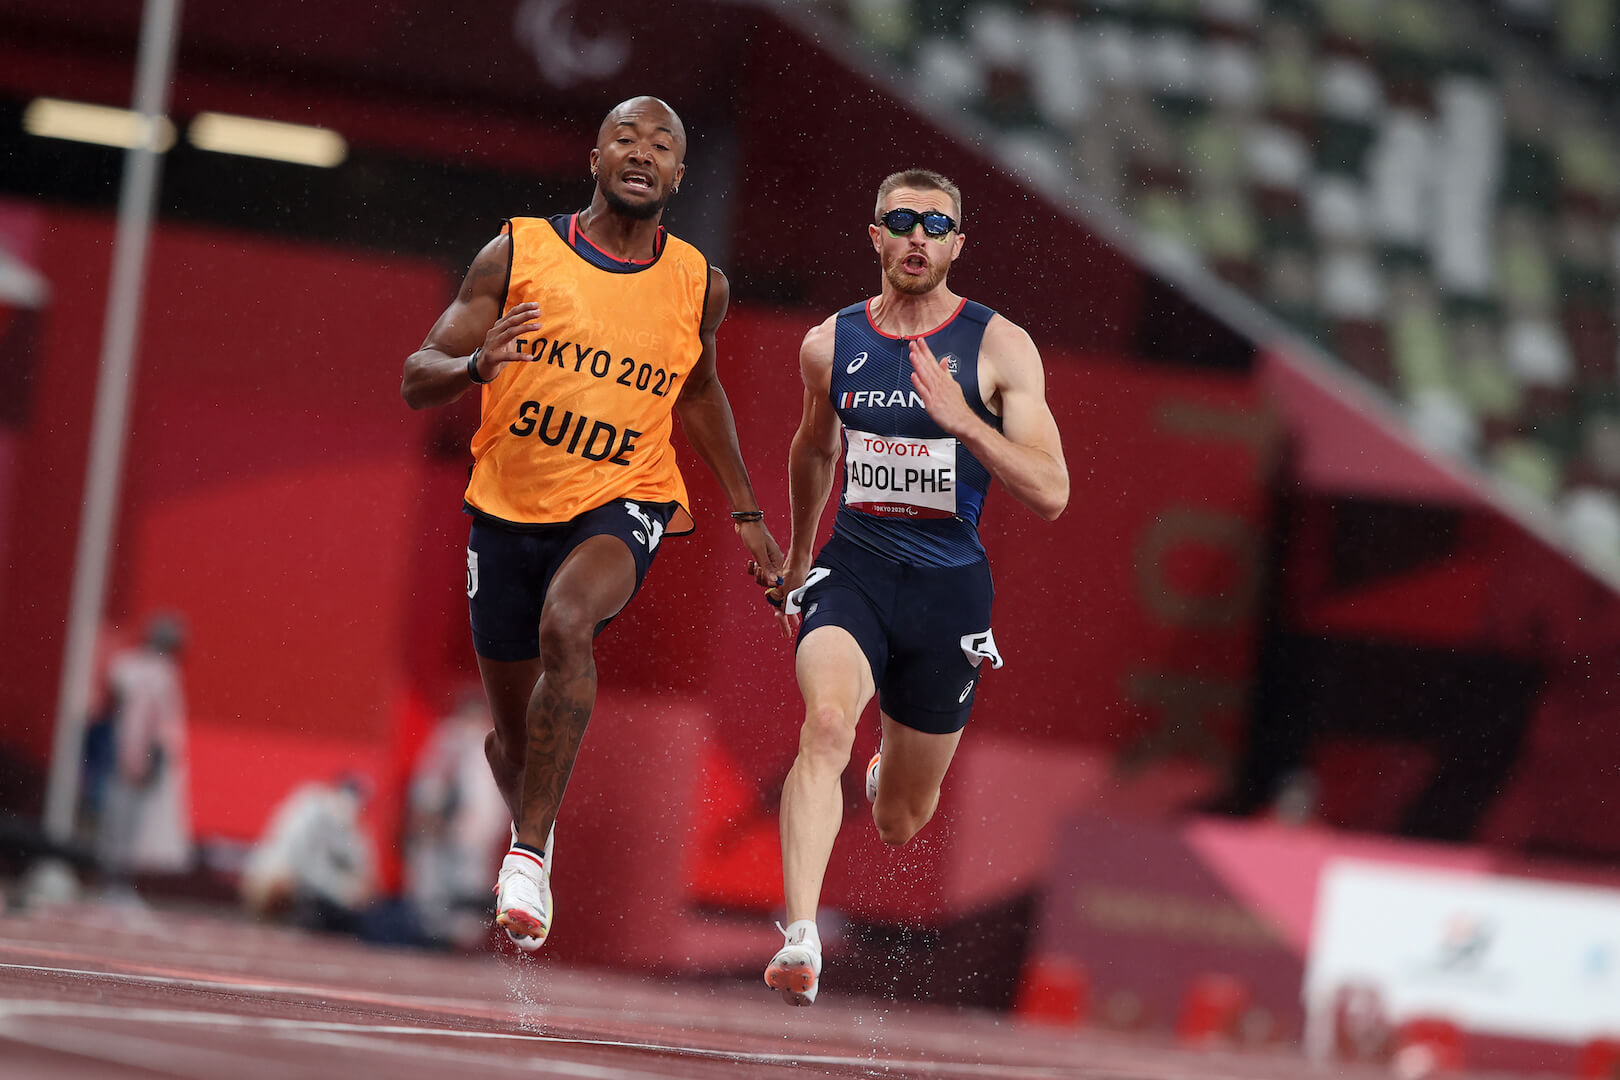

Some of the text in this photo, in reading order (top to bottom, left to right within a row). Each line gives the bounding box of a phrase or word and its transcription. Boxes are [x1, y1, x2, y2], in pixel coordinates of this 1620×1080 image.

[852, 390, 926, 409] FRAN
[509, 400, 642, 466] GUIDE
[863, 438, 930, 457] TOYOTA
[851, 460, 952, 493] ADOLPHE
[873, 504, 905, 514] TOKYO 2020
